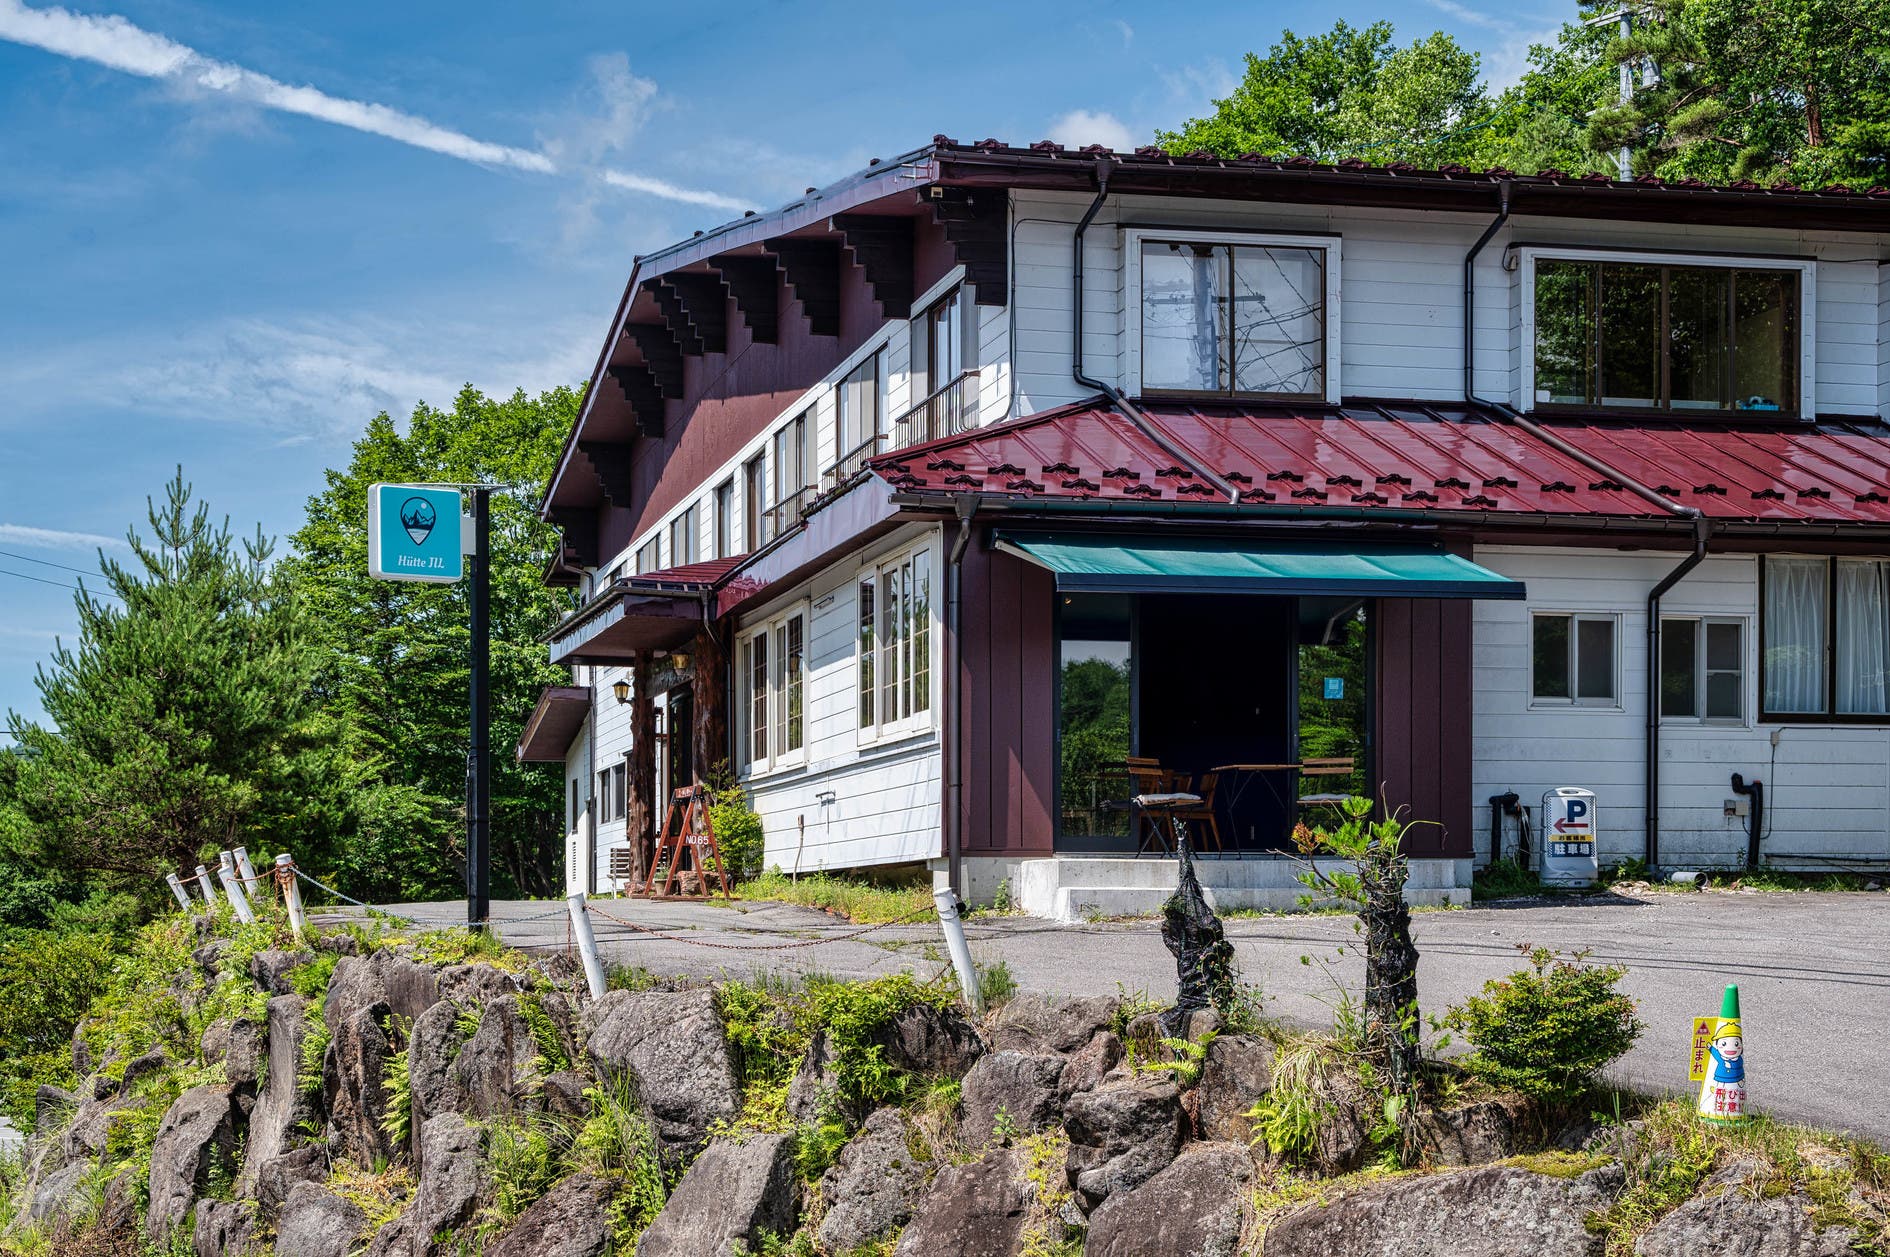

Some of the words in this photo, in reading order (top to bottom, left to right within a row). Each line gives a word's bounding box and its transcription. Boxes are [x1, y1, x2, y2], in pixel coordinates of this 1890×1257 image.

[398, 555, 426, 568] Hütte
[1567, 800, 1587, 823] P
[1554, 843, 1590, 855] 駐車場
[1693, 1036, 1706, 1073] 止まれ
